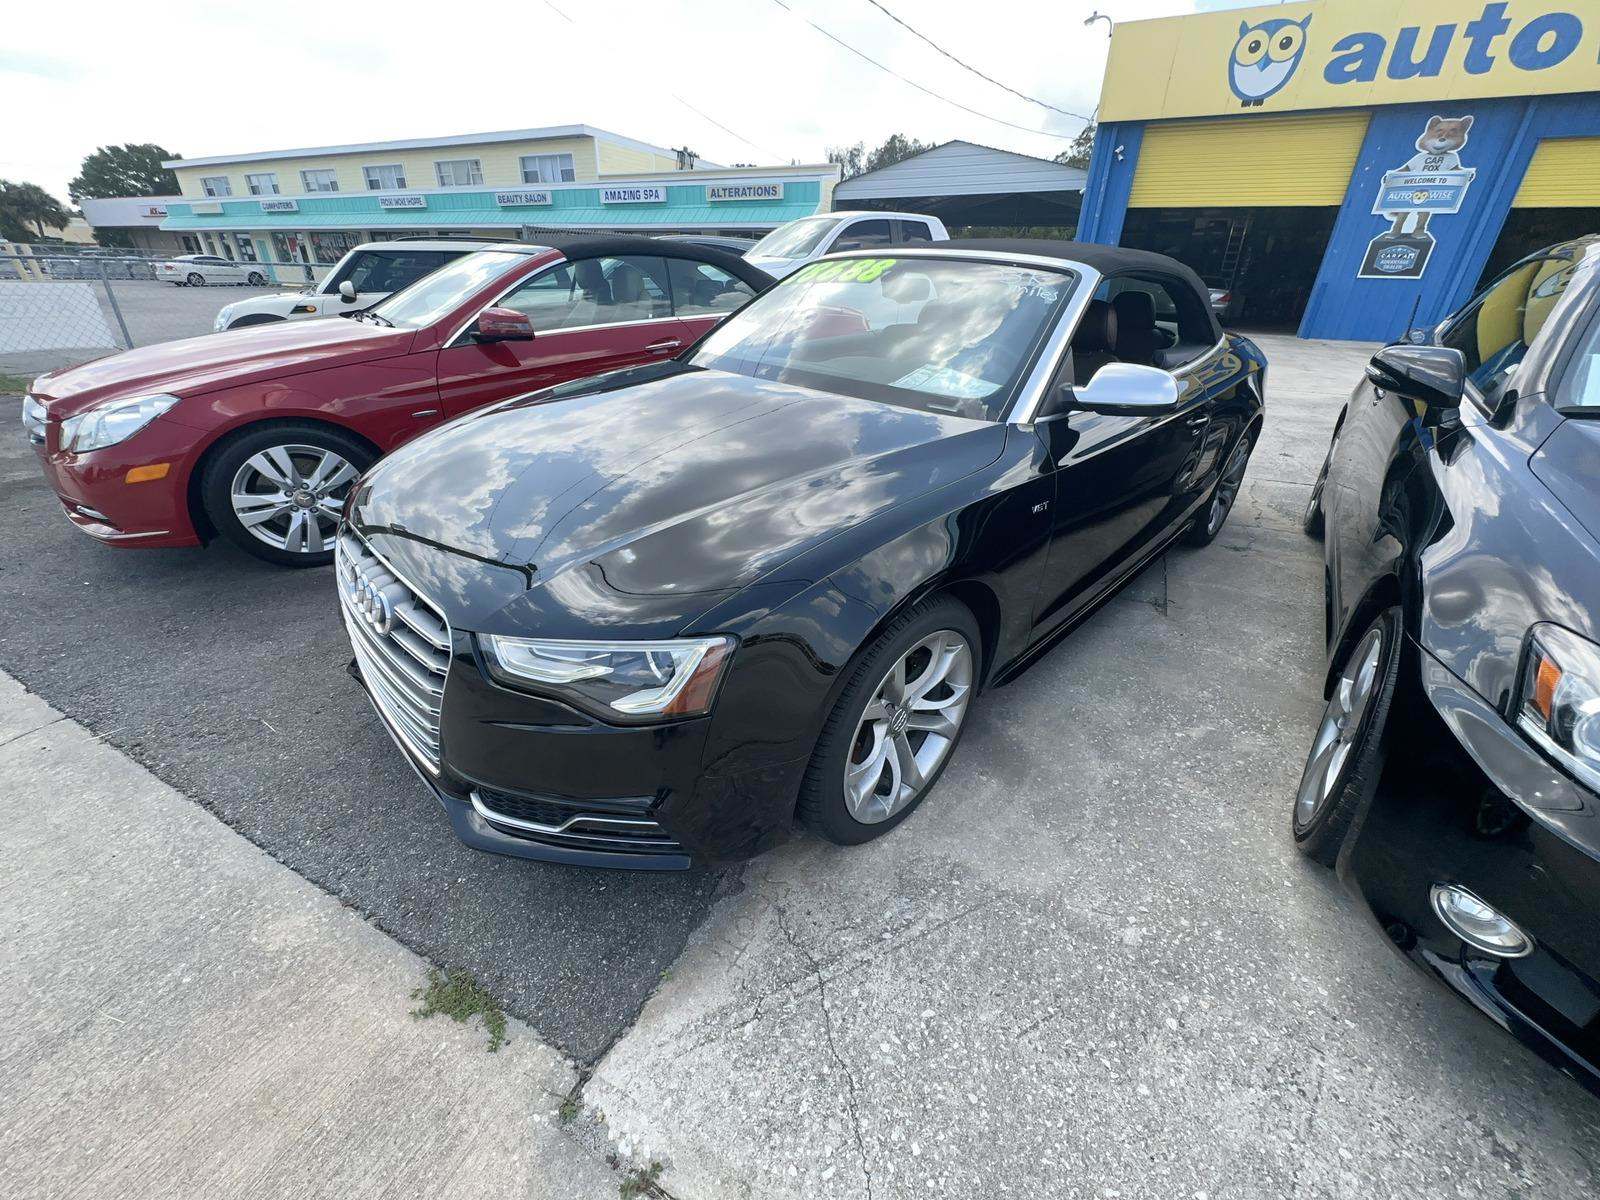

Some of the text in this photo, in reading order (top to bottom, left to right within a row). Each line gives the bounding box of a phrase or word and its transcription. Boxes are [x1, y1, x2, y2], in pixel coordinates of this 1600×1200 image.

[1323, 3, 1583, 85] auto
[1424, 156, 1444, 164] CAR
[1403, 177, 1436, 185] WELCOME
[604, 186, 660, 203] AMAZING SPA
[710, 184, 778, 199] ALTERATIONS
[1387, 191, 1454, 200] AUTO WISE
[497, 192, 547, 204] BEAUTY SALON
[261, 201, 294, 210] COMPUTERS
